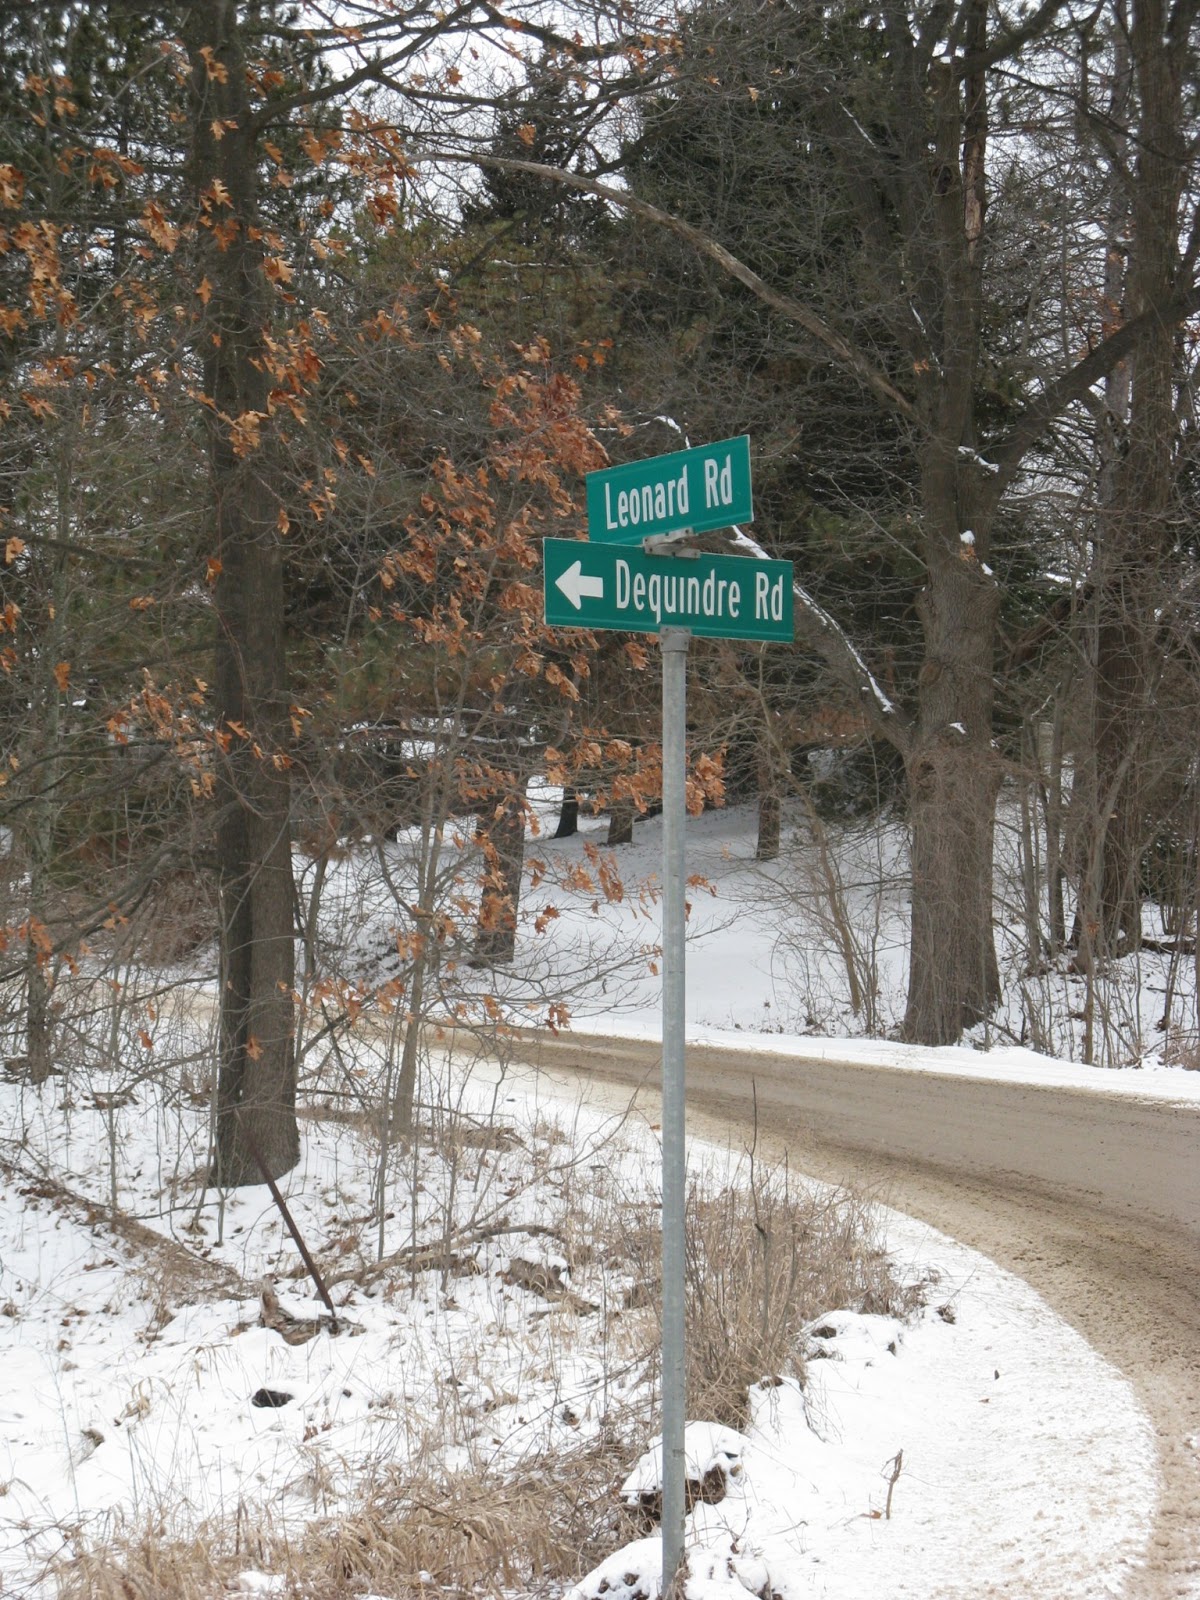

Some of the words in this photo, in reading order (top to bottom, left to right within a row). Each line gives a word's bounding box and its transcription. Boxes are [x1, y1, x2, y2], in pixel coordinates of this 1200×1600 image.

[605, 464, 689, 530] Leonard
[704, 455, 733, 508] Rd
[615, 559, 741, 624] Dequindre
[755, 571, 784, 621] Rd
